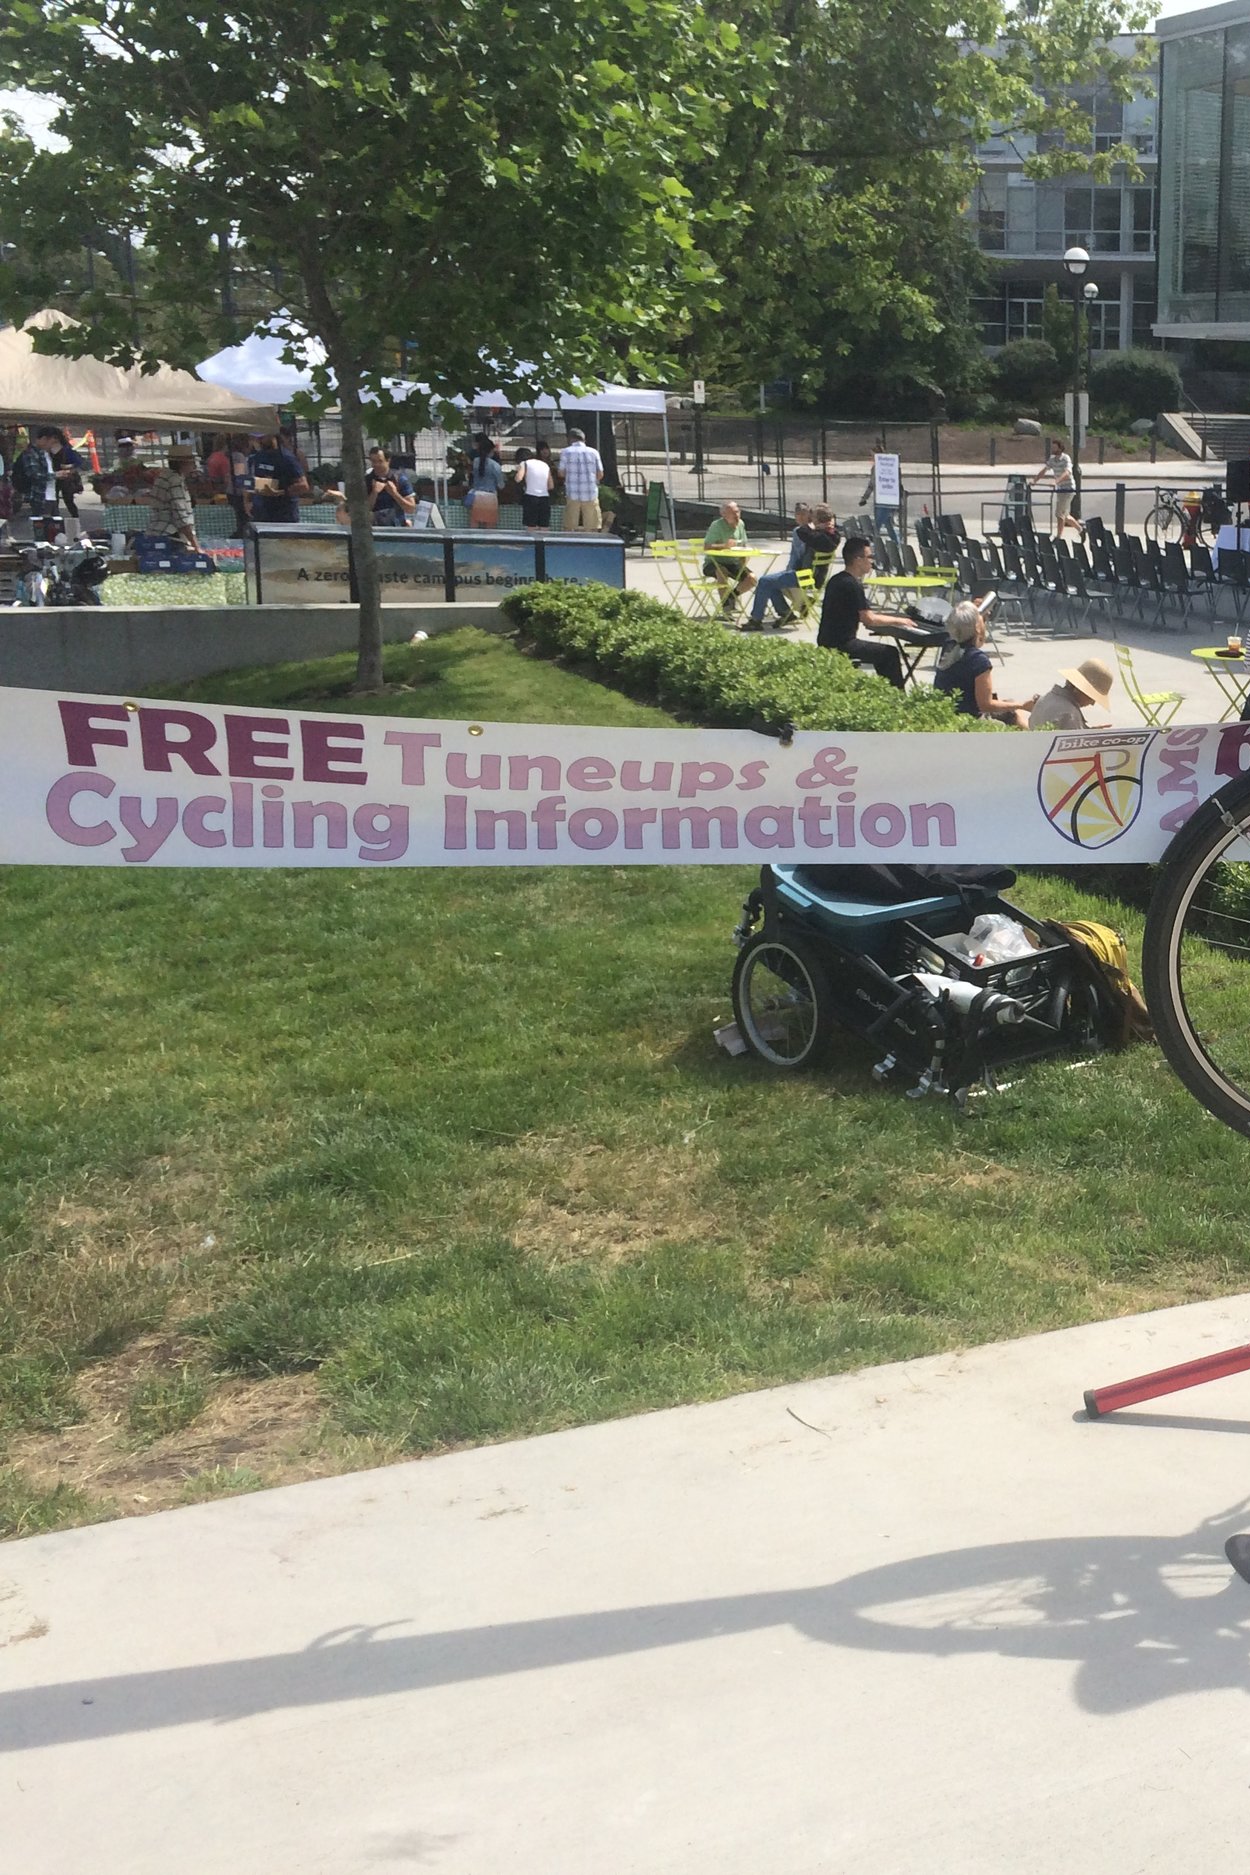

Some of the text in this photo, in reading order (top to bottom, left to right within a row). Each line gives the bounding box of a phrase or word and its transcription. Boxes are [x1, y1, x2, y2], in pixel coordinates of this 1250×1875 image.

[297, 567, 310, 581] A
[314, 571, 350, 582] zero
[413, 573, 482, 588] campus
[485, 572, 534, 588] begins
[544, 573, 583, 586] hre.
[57, 700, 859, 798] FREE Tuneups &
[1060, 735, 1147, 751] bike co-op
[45, 771, 957, 862] Cycling Information
